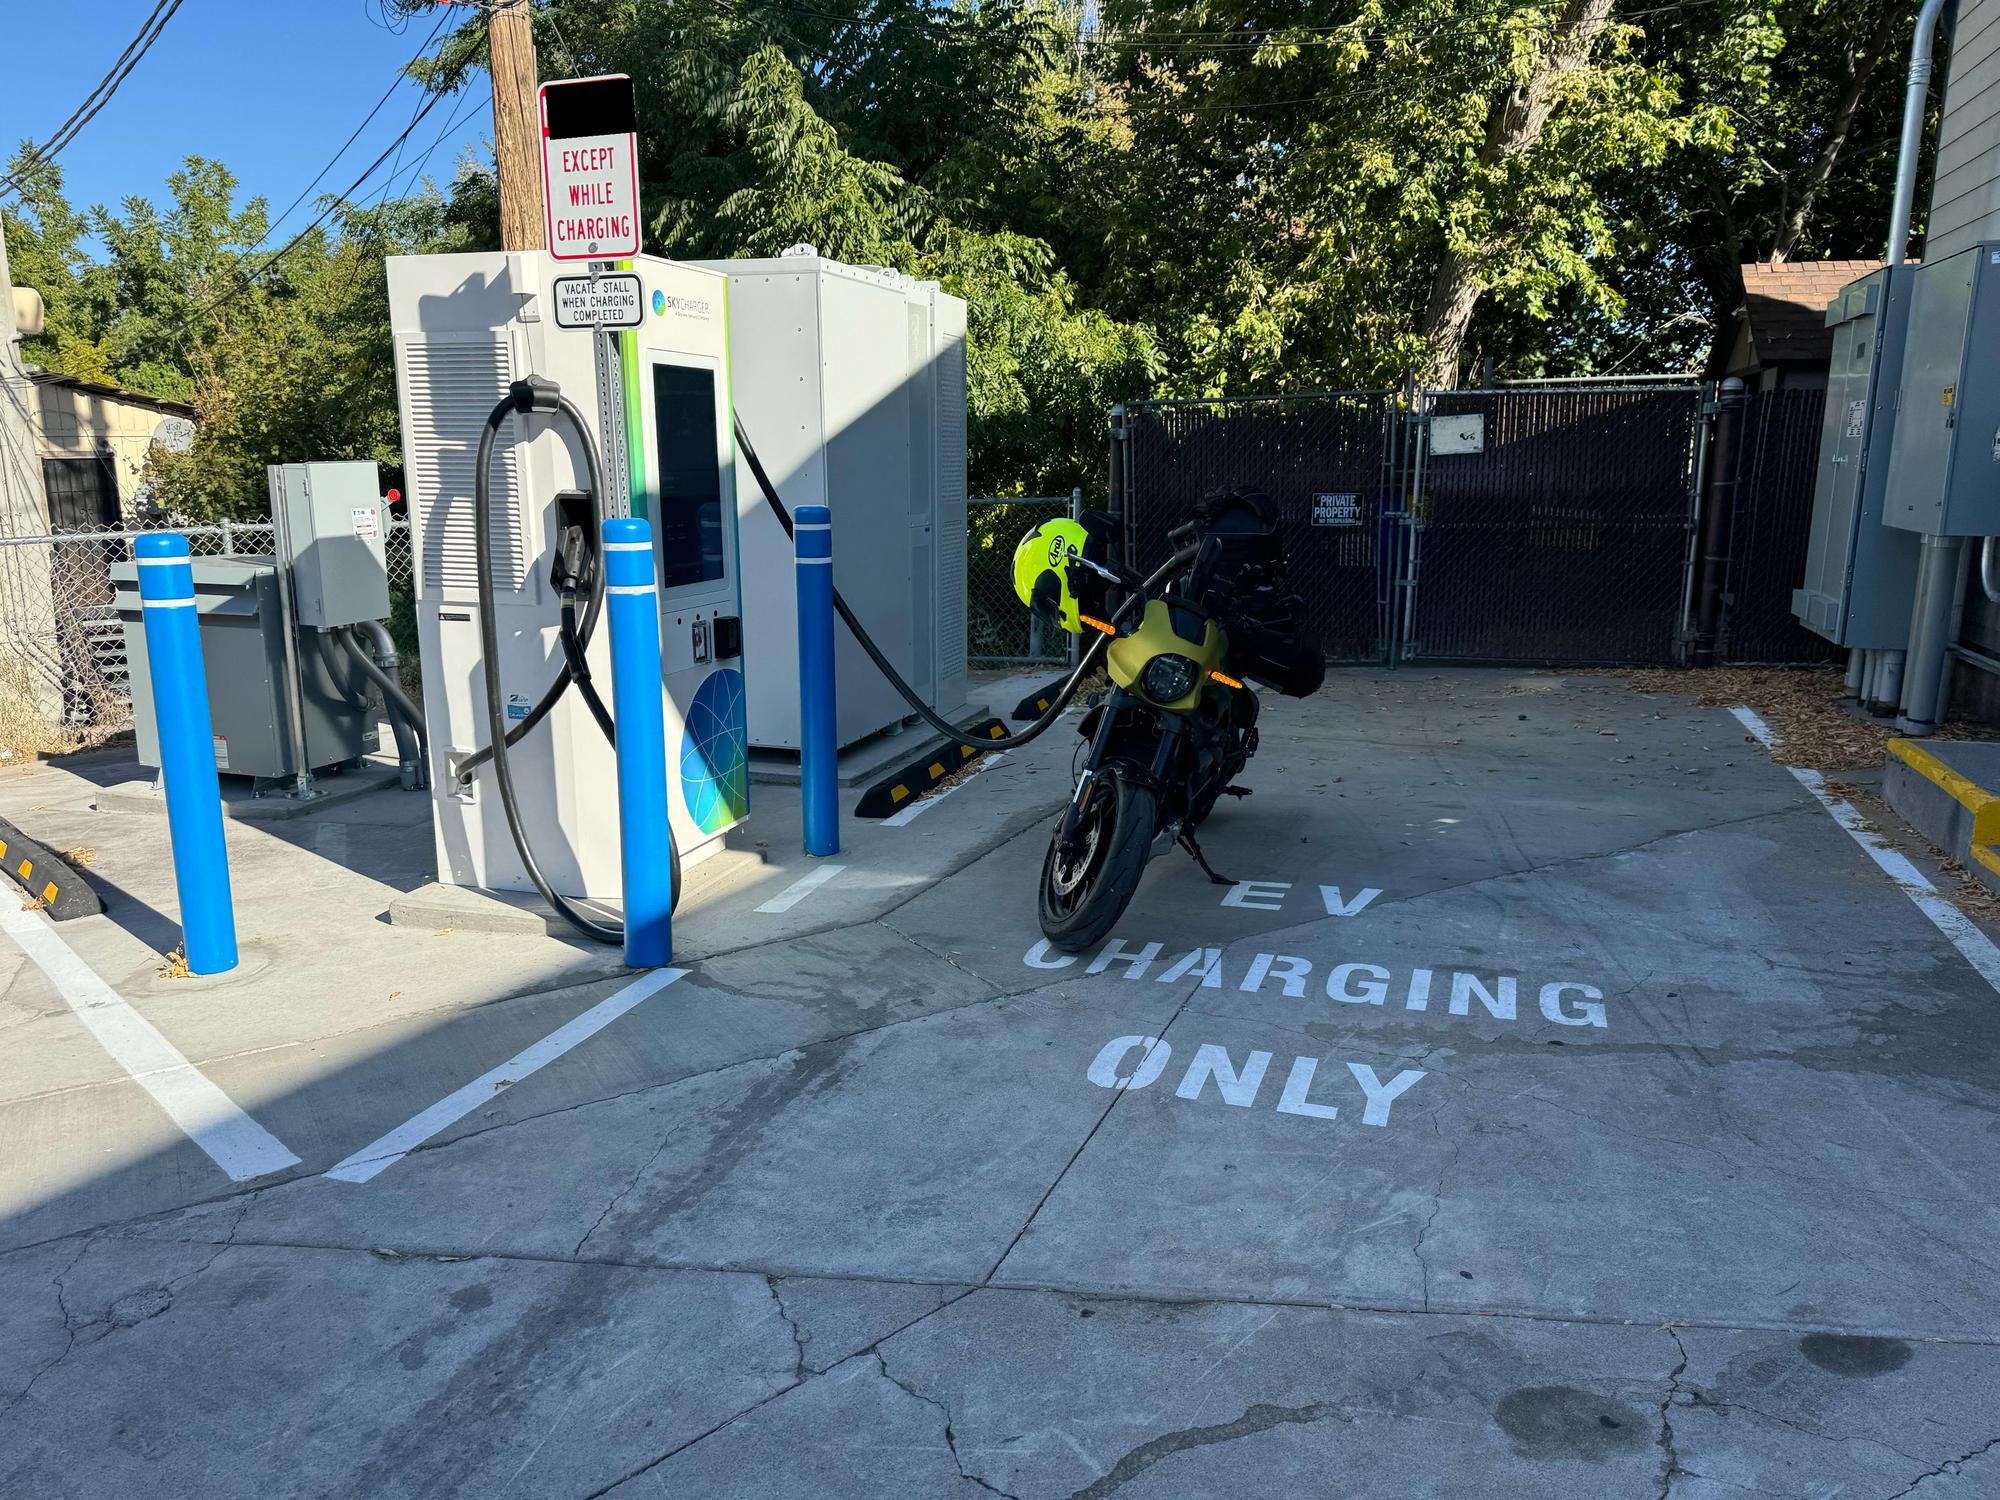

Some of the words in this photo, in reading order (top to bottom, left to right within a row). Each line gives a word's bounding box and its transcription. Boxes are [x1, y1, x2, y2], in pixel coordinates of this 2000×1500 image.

[563, 147, 614, 173] EXCEPT
[569, 182, 614, 206] WHILE
[557, 215, 630, 241] CHARGING
[564, 283, 597, 295] VACATE
[603, 281, 630, 293] STALL
[562, 297, 586, 308] WHEN
[590, 294, 634, 307] CHARGING
[667, 296, 709, 314] SKYCHARGER
[573, 309, 624, 321] COMPLETED
[1314, 506, 1361, 518] PROPERTY
[1320, 495, 1356, 506] PRIVATE
[1049, 537, 1062, 565] Arai
[1220, 880, 1383, 916] EV
[1022, 937, 1608, 1028] CHARGING
[1087, 1035, 1428, 1127] ONLY
